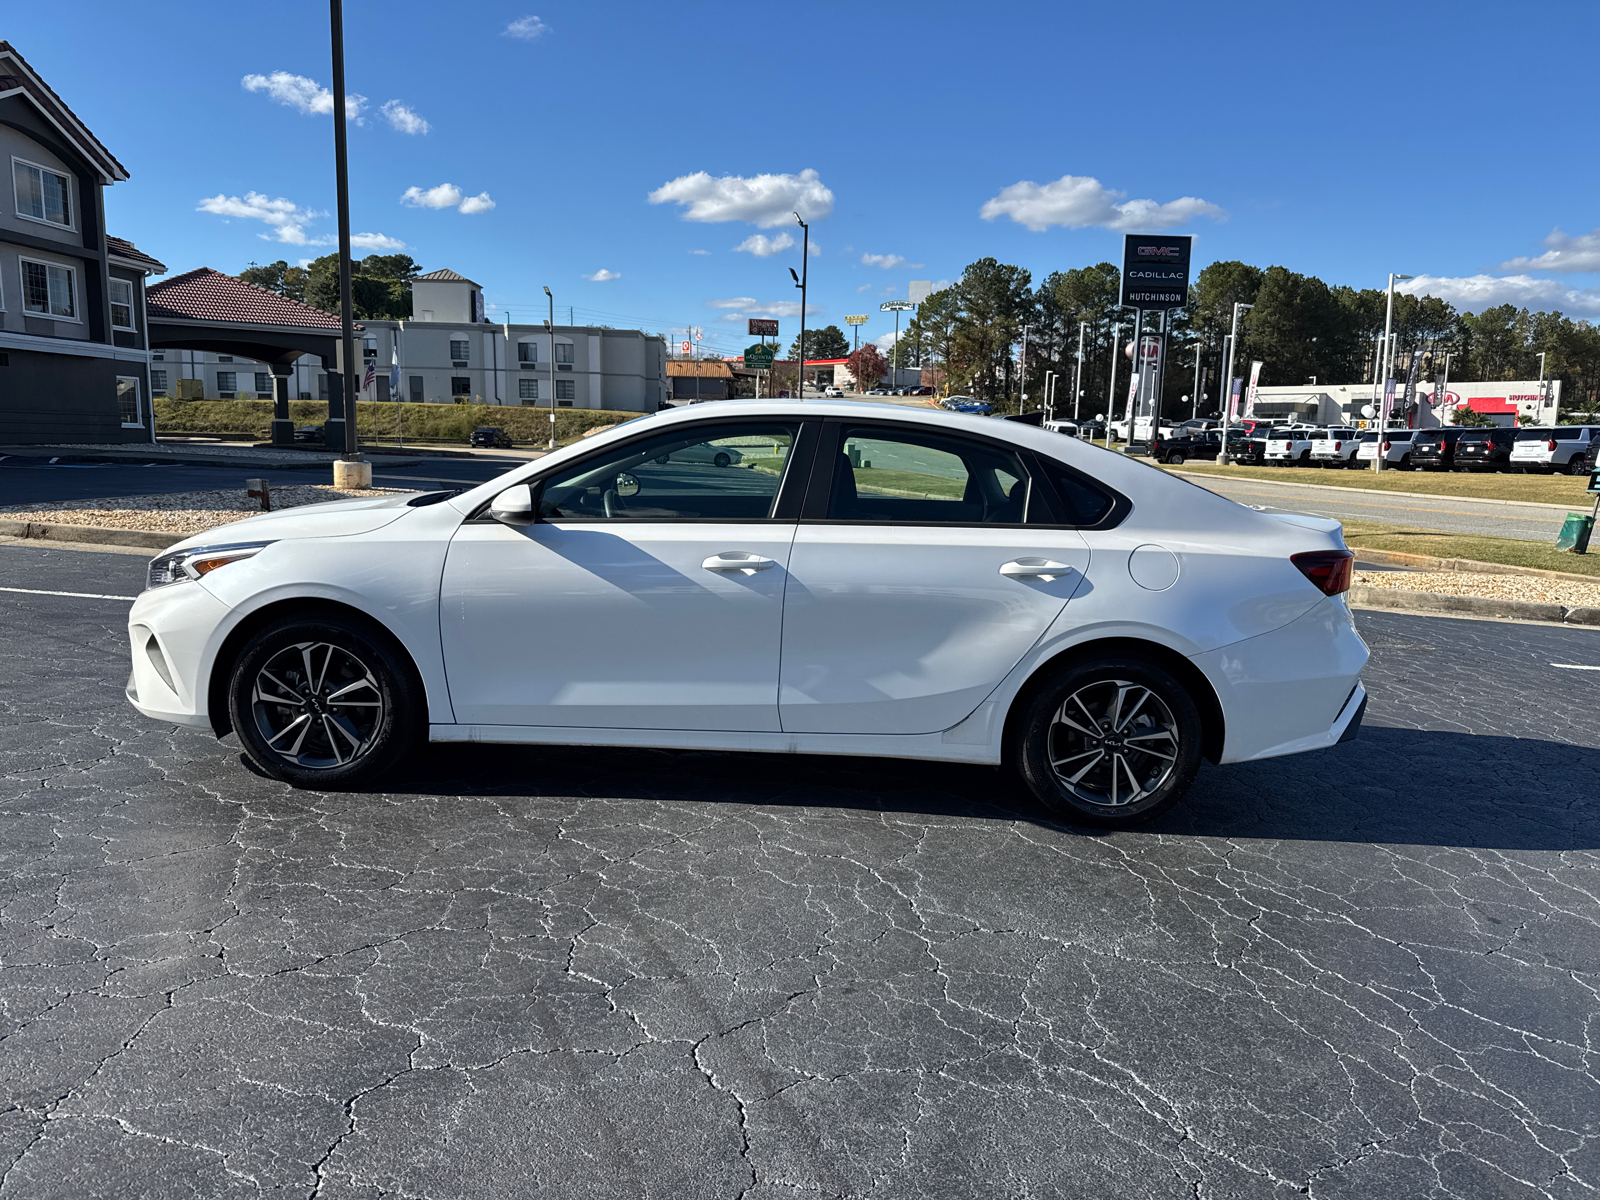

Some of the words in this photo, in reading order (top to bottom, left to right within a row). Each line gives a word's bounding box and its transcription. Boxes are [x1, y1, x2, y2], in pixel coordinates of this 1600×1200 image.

[1137, 246, 1180, 257] GMC
[1129, 271, 1184, 279] CADILLAC
[1129, 292, 1181, 302] HUTCHINSON
